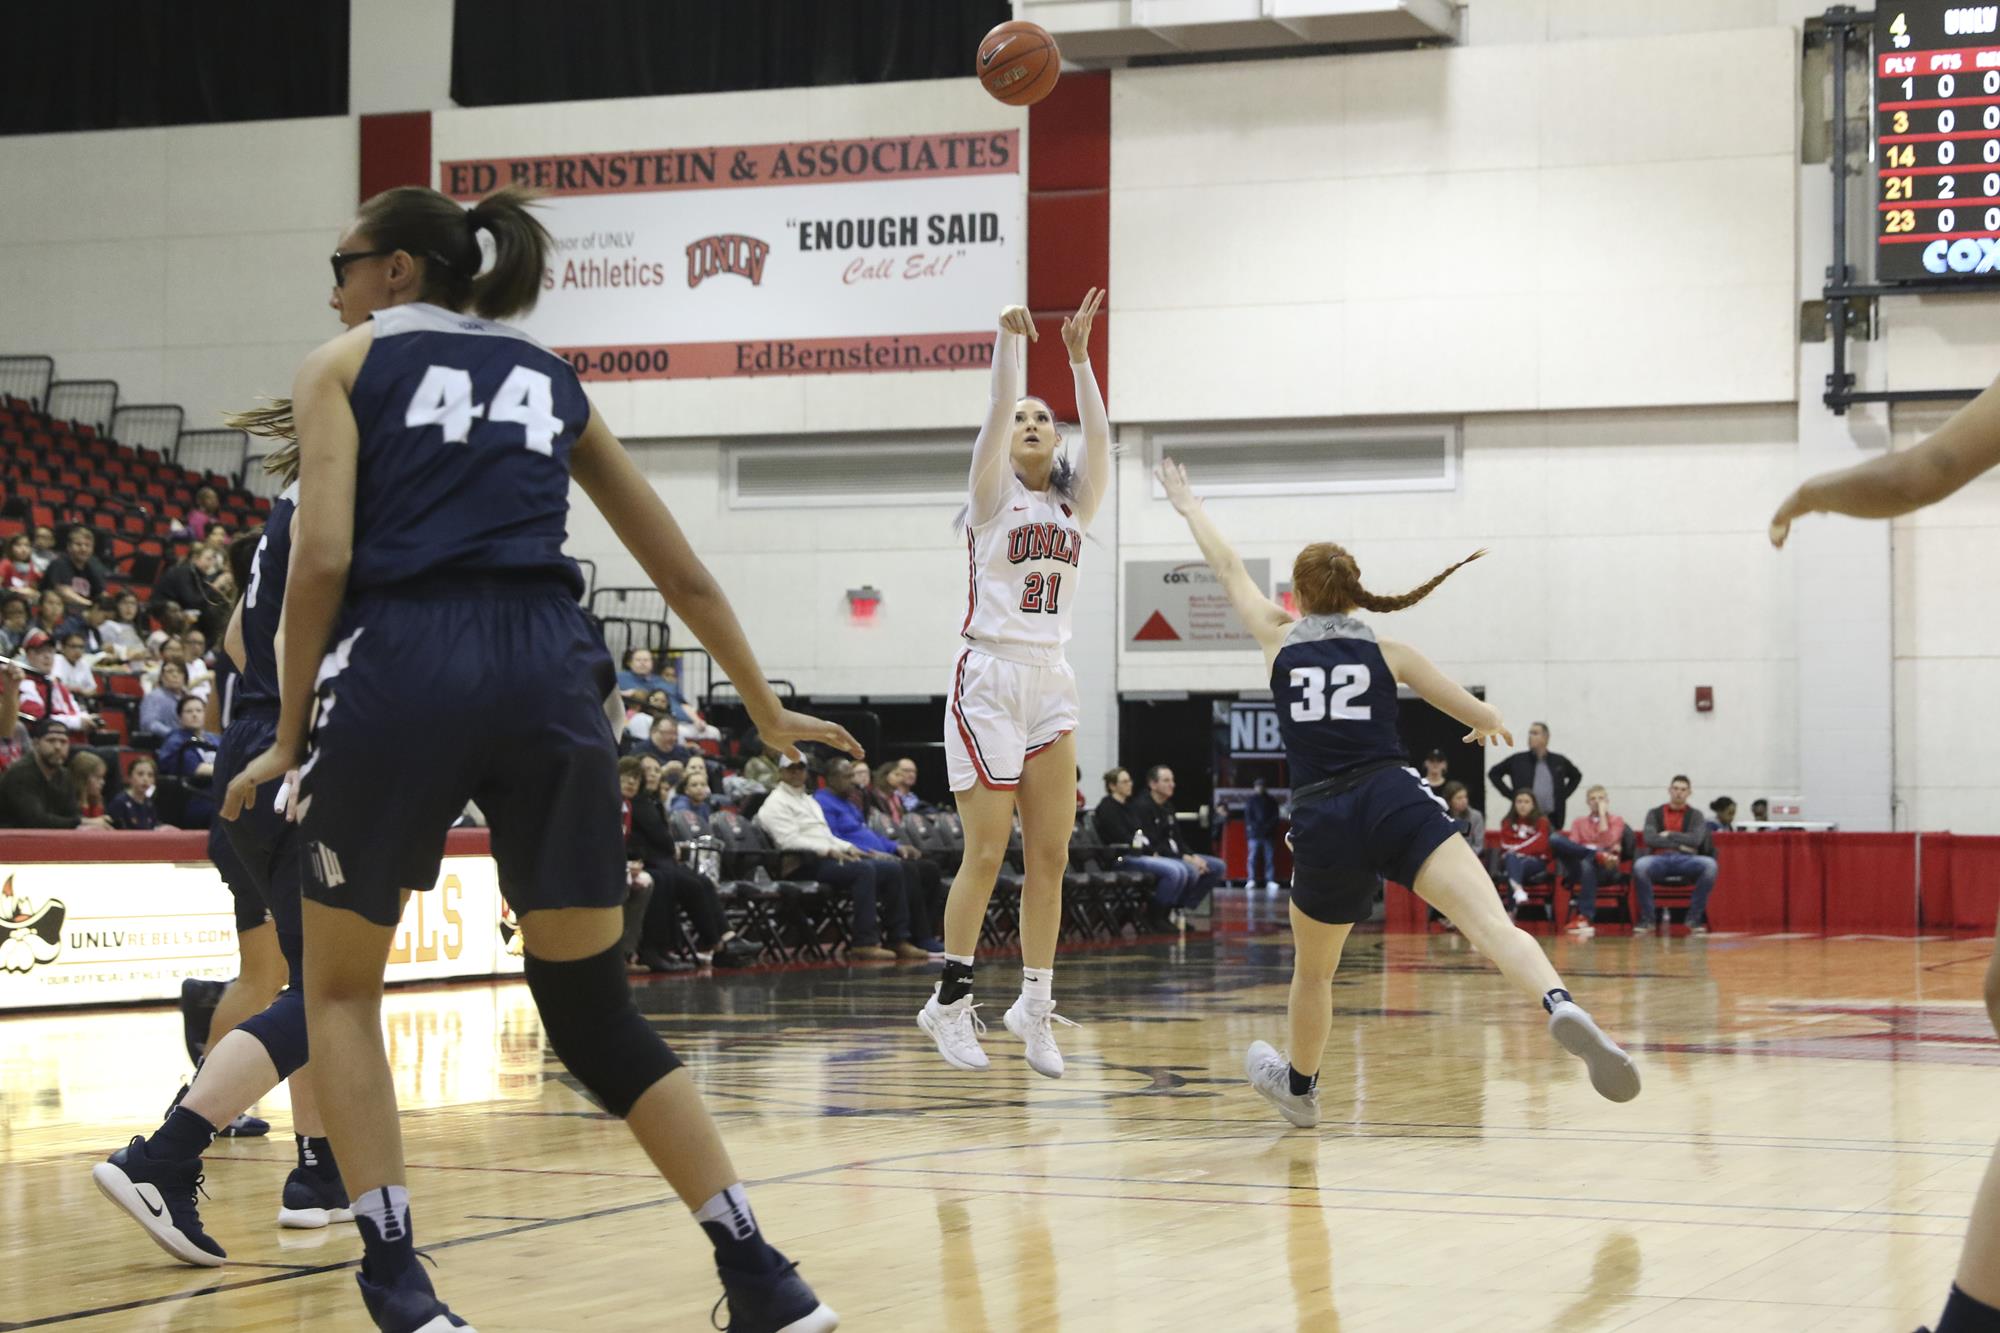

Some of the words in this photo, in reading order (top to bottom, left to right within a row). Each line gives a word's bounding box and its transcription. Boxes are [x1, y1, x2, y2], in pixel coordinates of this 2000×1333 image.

[1889, 12, 1907, 36] 4
[1944, 6, 1998, 35] UNLV
[1885, 56, 1916, 74] PLY
[1930, 53, 1962, 71] PTS
[1901, 76, 1913, 100] 1
[1938, 74, 1955, 98] 0
[1983, 70, 2000, 94] 0
[1893, 110, 1909, 134] 3
[1938, 109, 1955, 133] 0
[1983, 105, 2000, 130] 0
[450, 163, 498, 195] ED
[508, 151, 717, 190] BERNSTEIN
[729, 149, 758, 181] &
[768, 134, 1010, 180] ASSOCIATES
[1886, 144, 1916, 168] 14
[1938, 141, 1955, 165] 0
[1983, 139, 2000, 163] 0
[1885, 175, 1914, 200] 21
[1938, 175, 1955, 199] 2
[1983, 172, 2000, 197] 0
[928, 212, 1004, 246] SAID,
[1885, 209, 1916, 233] 23
[1938, 208, 1955, 232] 0
[1984, 207, 2000, 231] 0
[582, 231, 595, 250] of
[599, 230, 635, 249] UNLV
[562, 257, 665, 291] Athletics
[686, 233, 770, 289] UNLV
[842, 257, 894, 285] Call
[735, 337, 994, 371] EdBernstein.com
[405, 364, 565, 458] 44
[1008, 522, 1082, 568] UNLV
[1019, 571, 1062, 615] 21
[1289, 663, 1372, 723] 32
[1230, 710, 1286, 750] NB
